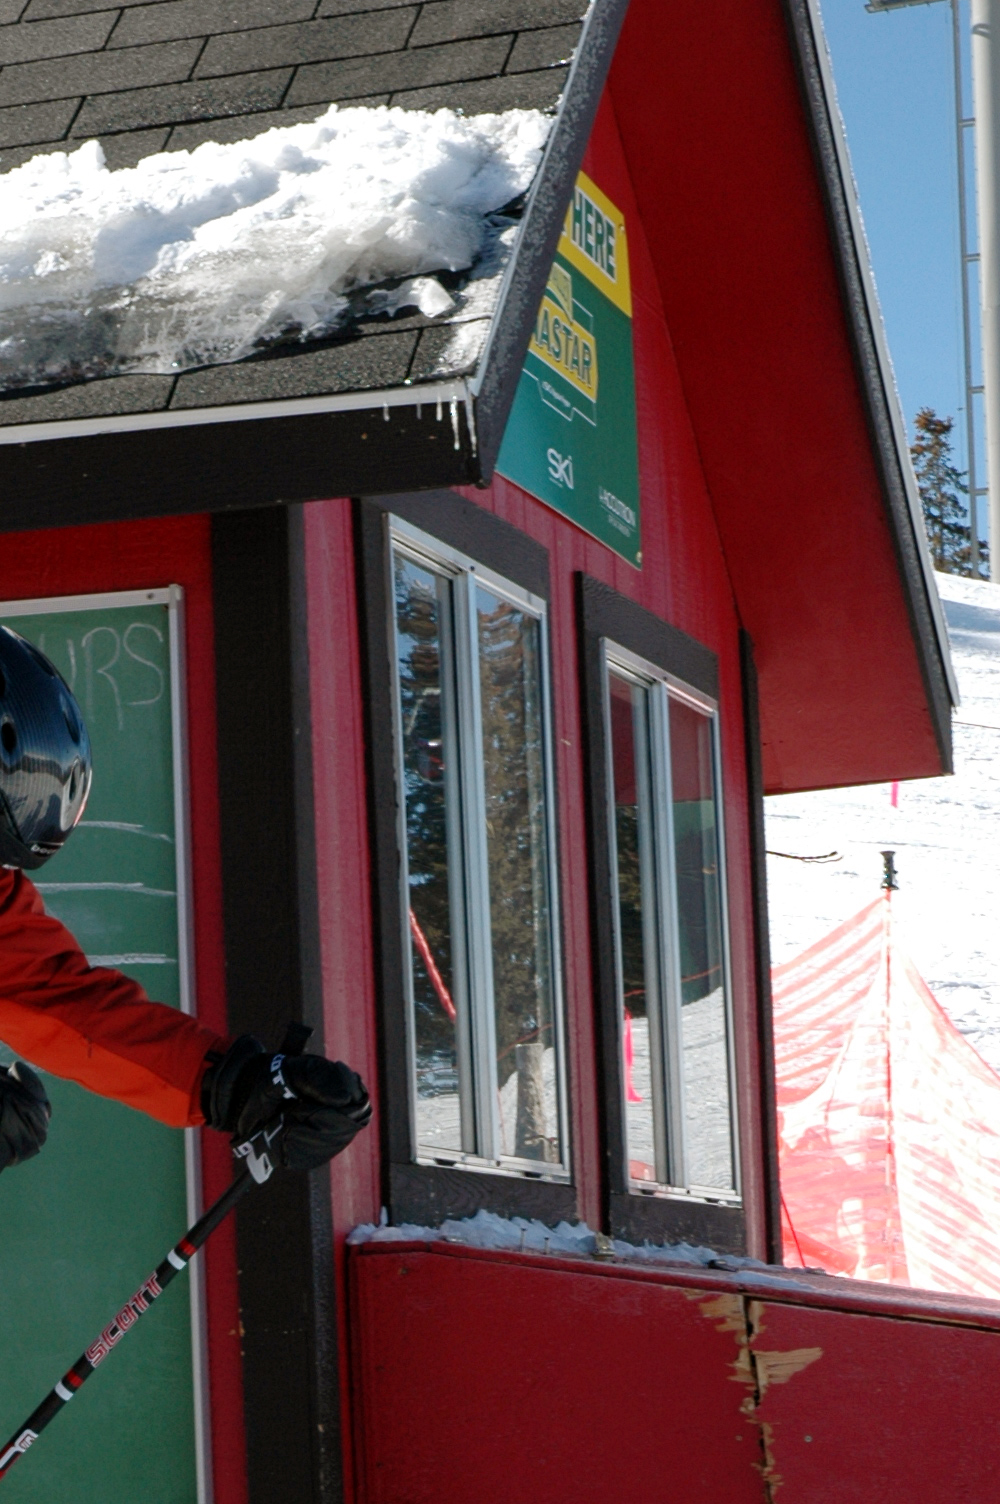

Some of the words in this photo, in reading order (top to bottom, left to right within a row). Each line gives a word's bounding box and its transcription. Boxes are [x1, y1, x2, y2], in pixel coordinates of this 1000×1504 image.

[570, 186, 617, 283] HERE
[530, 306, 593, 390] ASTAR
[85, 1270, 164, 1369] SCOTT
